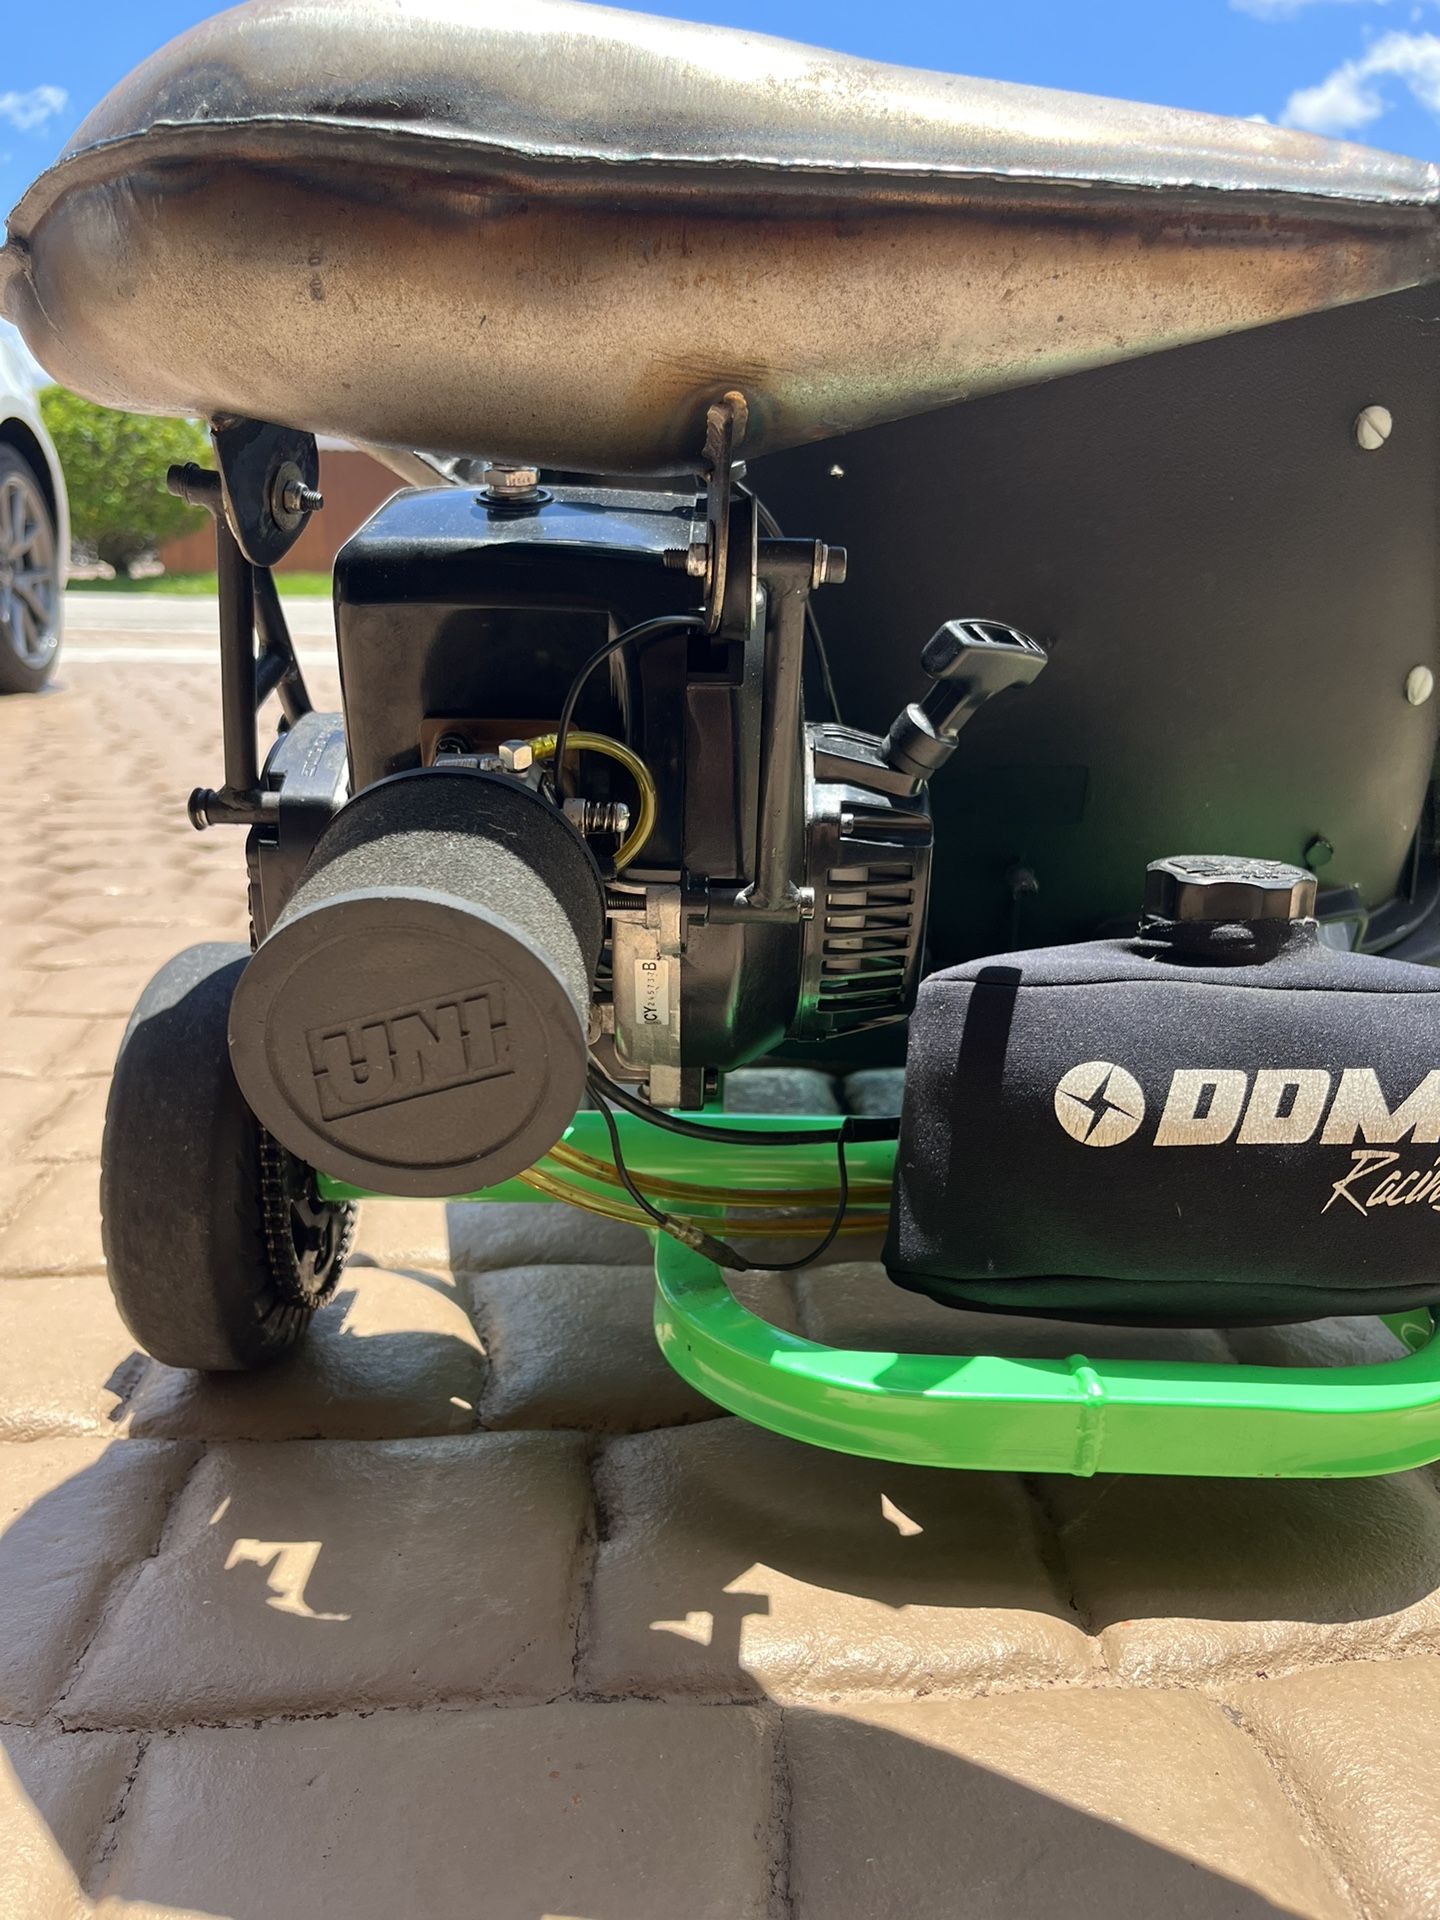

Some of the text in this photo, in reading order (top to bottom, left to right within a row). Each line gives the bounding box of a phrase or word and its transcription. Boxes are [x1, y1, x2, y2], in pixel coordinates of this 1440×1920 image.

[321, 993, 499, 1105] UNI
[1153, 1068, 1440, 1146] DDM
[1321, 1149, 1440, 1216] Racin
